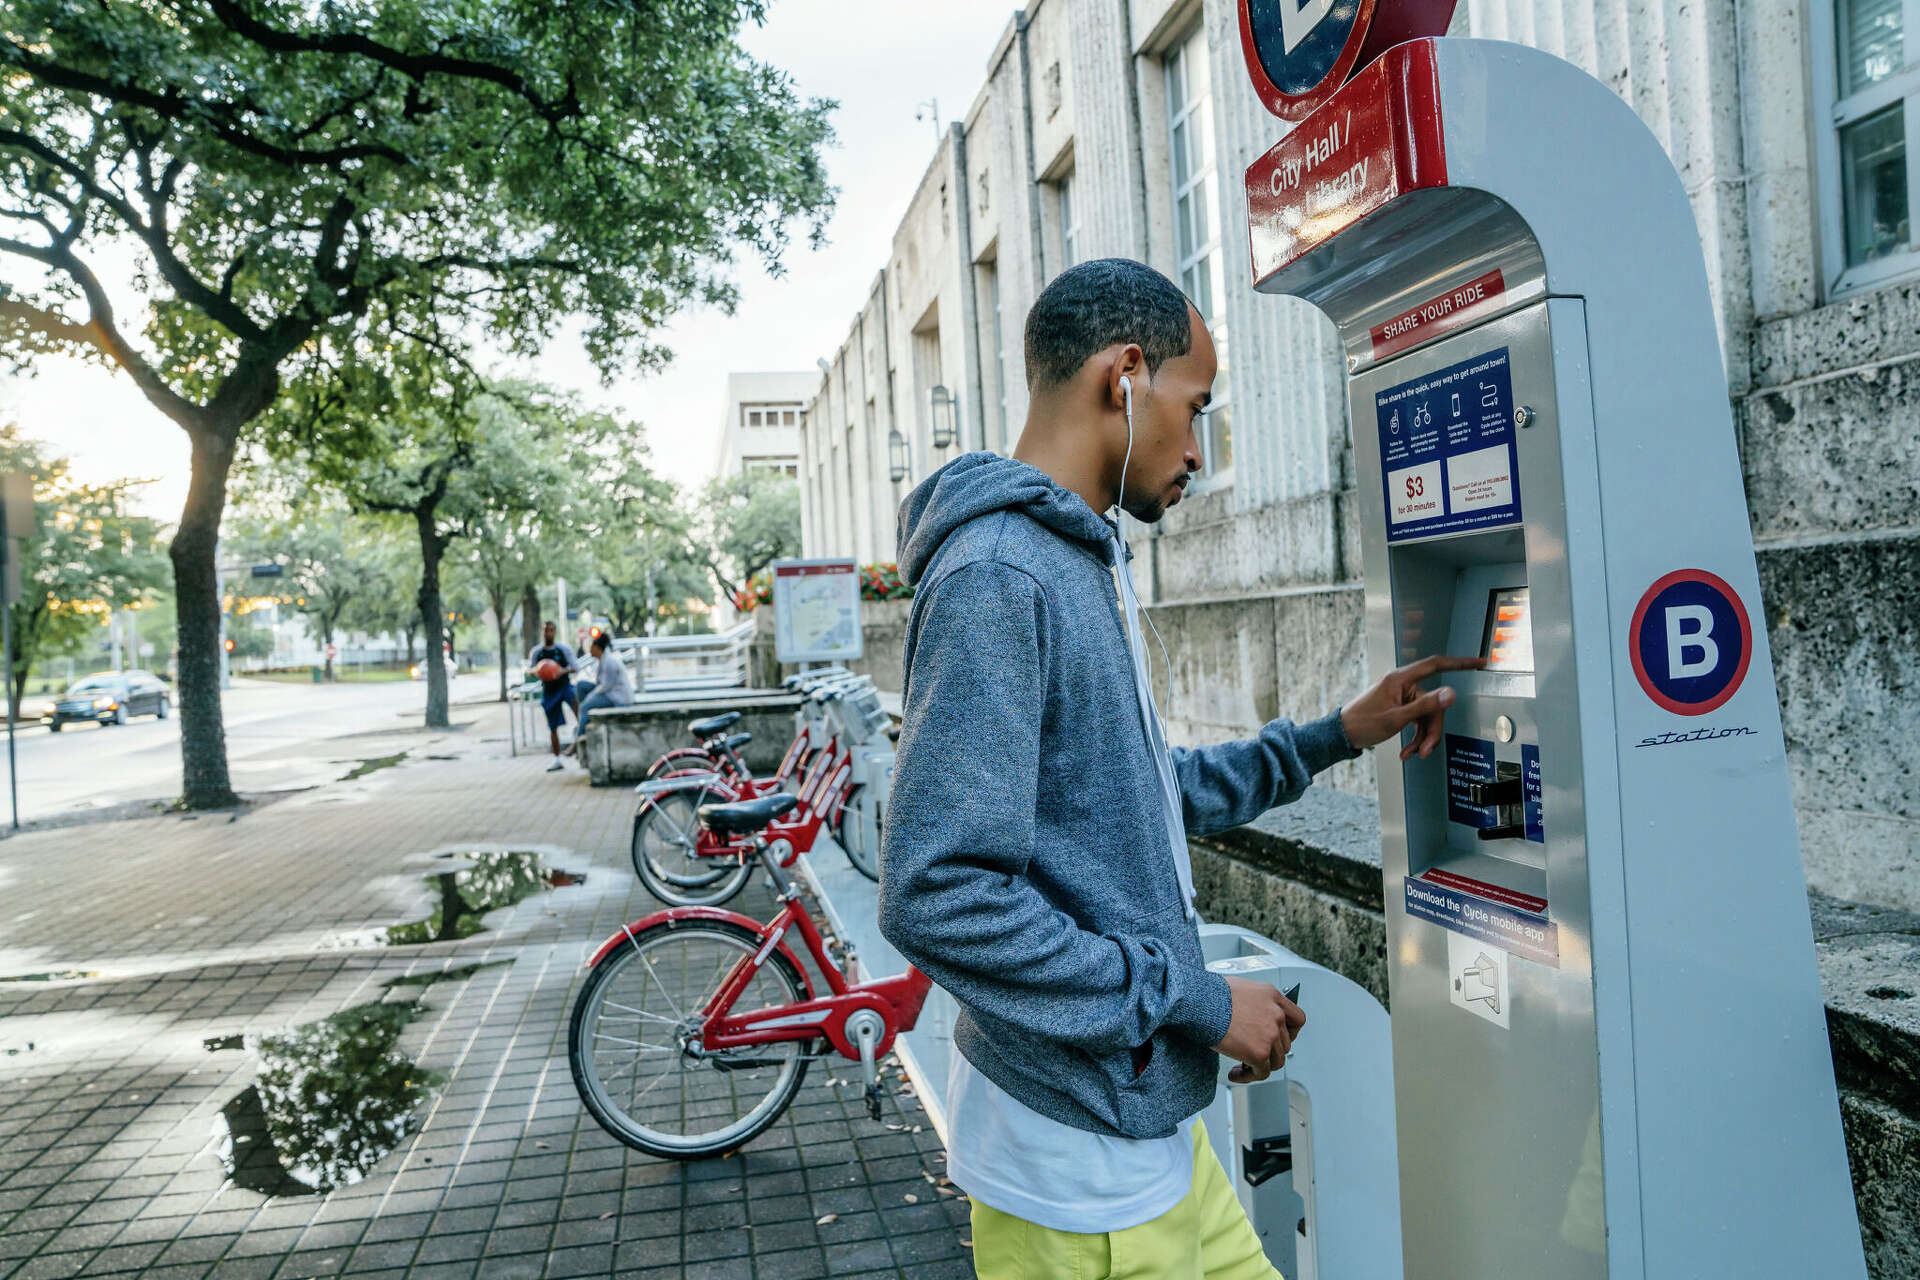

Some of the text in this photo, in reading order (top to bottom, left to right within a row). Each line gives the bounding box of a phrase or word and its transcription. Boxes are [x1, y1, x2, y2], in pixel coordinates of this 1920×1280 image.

[1271, 158, 1302, 197] City
[1384, 283, 1485, 340] SHARE YOUR RIDE
[1430, 379, 1442, 388] easy
[1442, 375, 1452, 384] way
[1453, 371, 1459, 380] to
[1460, 368, 1469, 380] get
[1470, 361, 1489, 375] around
[1406, 476, 1424, 500] $3
[1414, 502, 1436, 512] minutes
[1665, 604, 1720, 680] B
[1634, 727, 1758, 748] station
[1407, 884, 1445, 907] Download
[1447, 898, 1460, 912] the
[1464, 904, 1488, 922] Cycle
[1490, 914, 1523, 935] mobile
[1524, 926, 1544, 942] app
